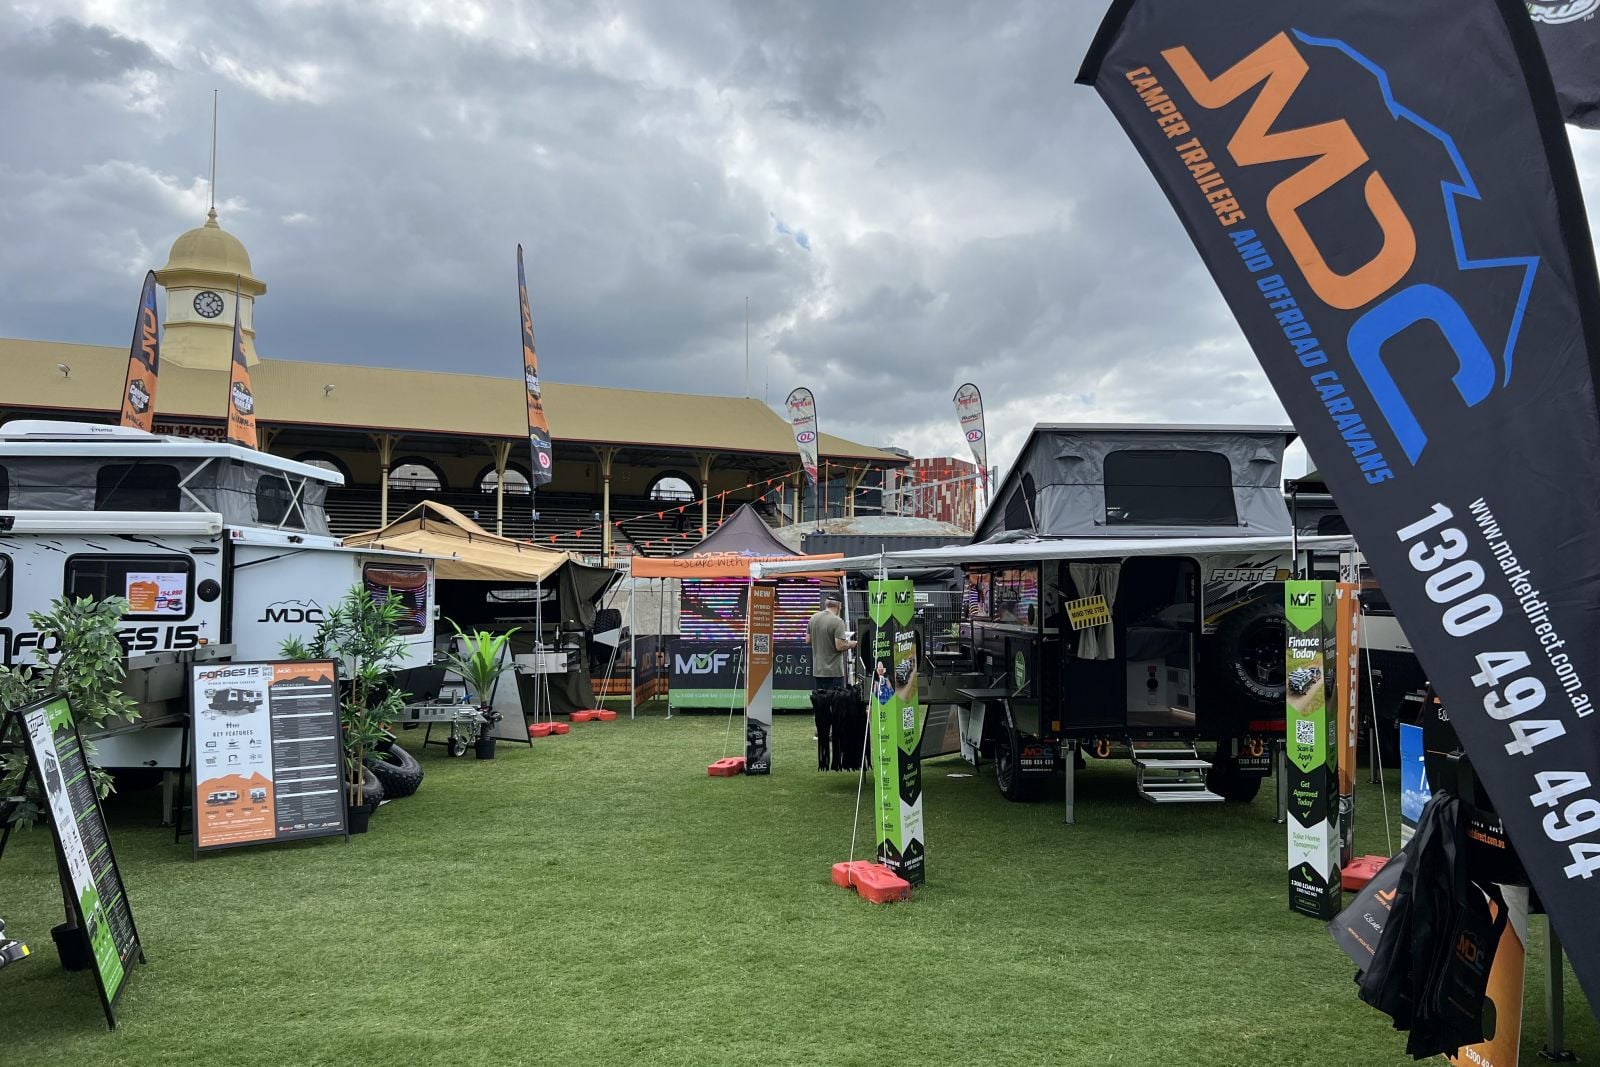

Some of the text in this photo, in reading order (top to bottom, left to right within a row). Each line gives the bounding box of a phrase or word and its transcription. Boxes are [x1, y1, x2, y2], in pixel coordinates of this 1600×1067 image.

[1161, 31, 1496, 466] MDC
[1125, 66, 1394, 486] CAMPER TRAILERS AND OFFROAD CARAVANS
[753, 590, 771, 598] NEW
[894, 591, 912, 605] MDF
[1290, 593, 1317, 606] MDF
[1084, 608, 1095, 616] THE
[1094, 605, 1105, 613] STEP
[1468, 497, 1595, 718] www.marketdirect.com.au
[12, 627, 158, 656] FOES
[894, 630, 915, 642] Finance
[1288, 636, 1320, 648] Finance
[897, 641, 913, 653] Today
[799, 654, 808, 664] &
[1292, 647, 1317, 660] Today
[675, 653, 731, 675] MDF
[198, 668, 246, 680] FORBES
[1396, 503, 1600, 880] 1300 494 494
[1297, 744, 1309, 752] Scan
[1298, 752, 1313, 761] Apply
[1300, 780, 1310, 788] Get
[1292, 788, 1318, 798] Approved
[1297, 798, 1313, 808] Today
[1465, 1046, 1481, 1065] 1300
